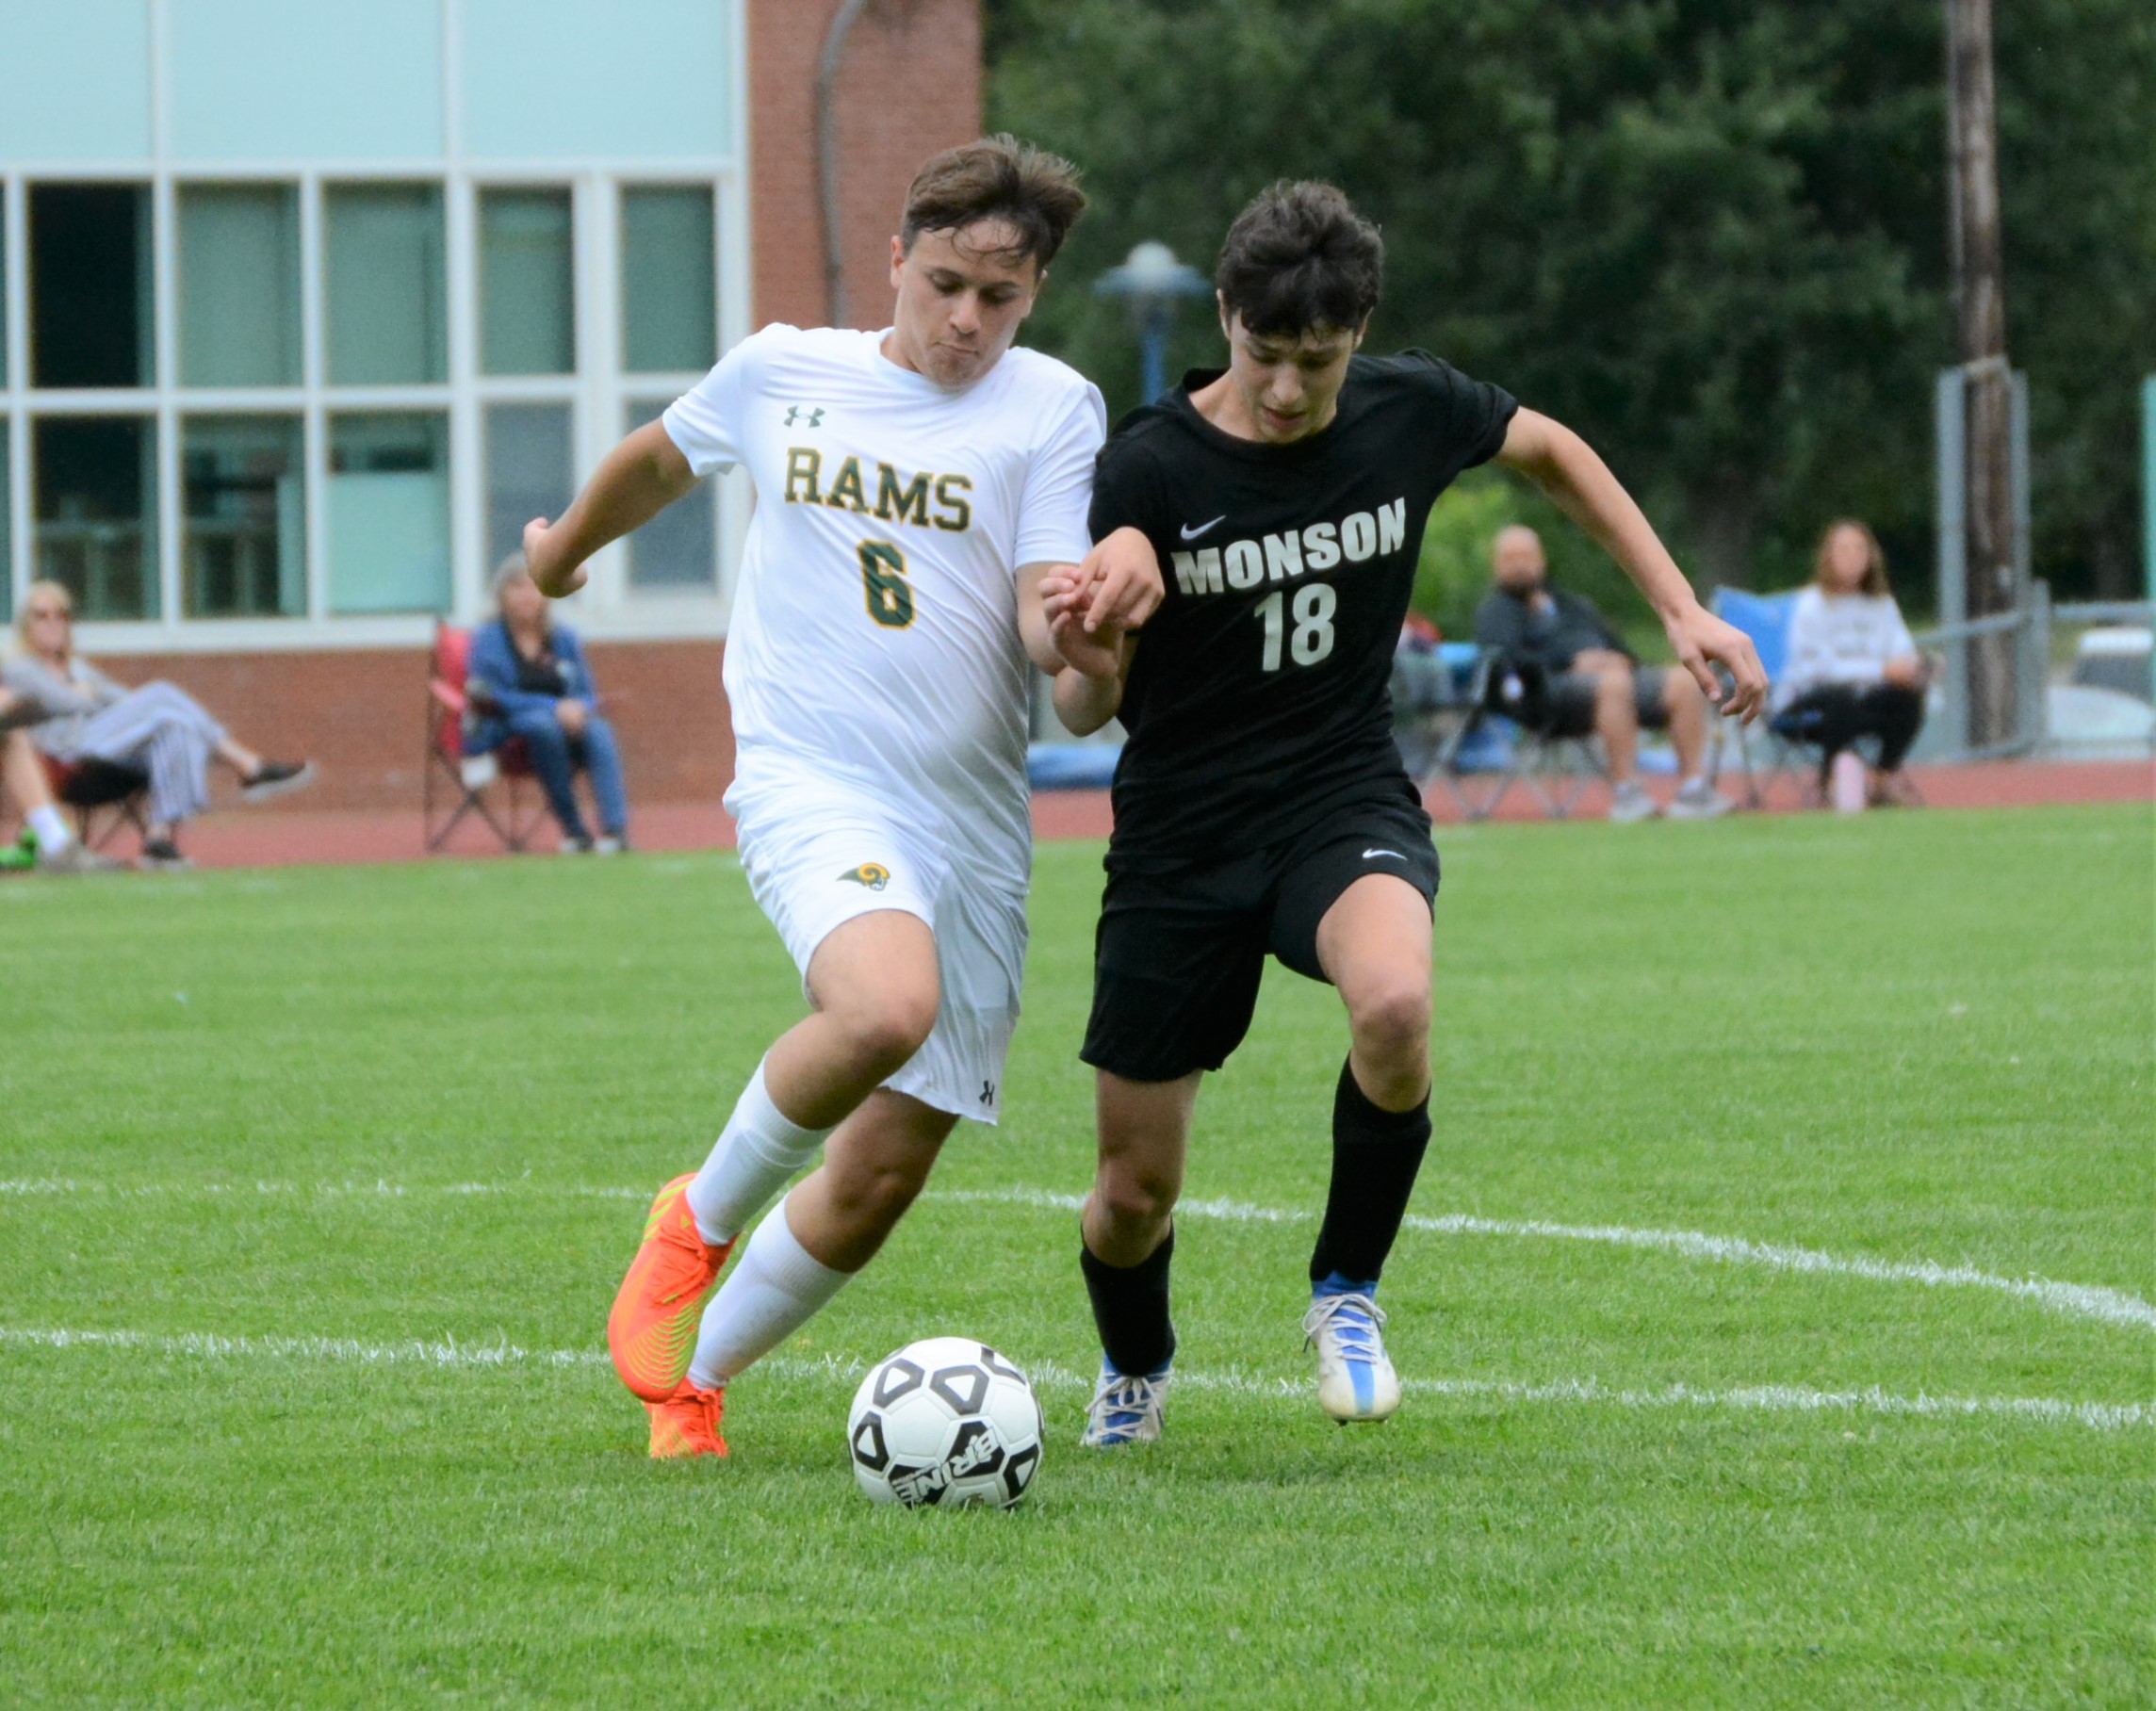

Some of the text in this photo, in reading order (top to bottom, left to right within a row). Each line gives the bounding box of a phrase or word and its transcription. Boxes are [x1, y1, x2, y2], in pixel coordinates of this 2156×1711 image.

[784, 447, 974, 533] RAMS
[857, 538, 918, 631] 6
[1170, 497, 1406, 595] MONSON
[1254, 582, 1336, 672] 18
[894, 1426, 1001, 1505] BRINE
